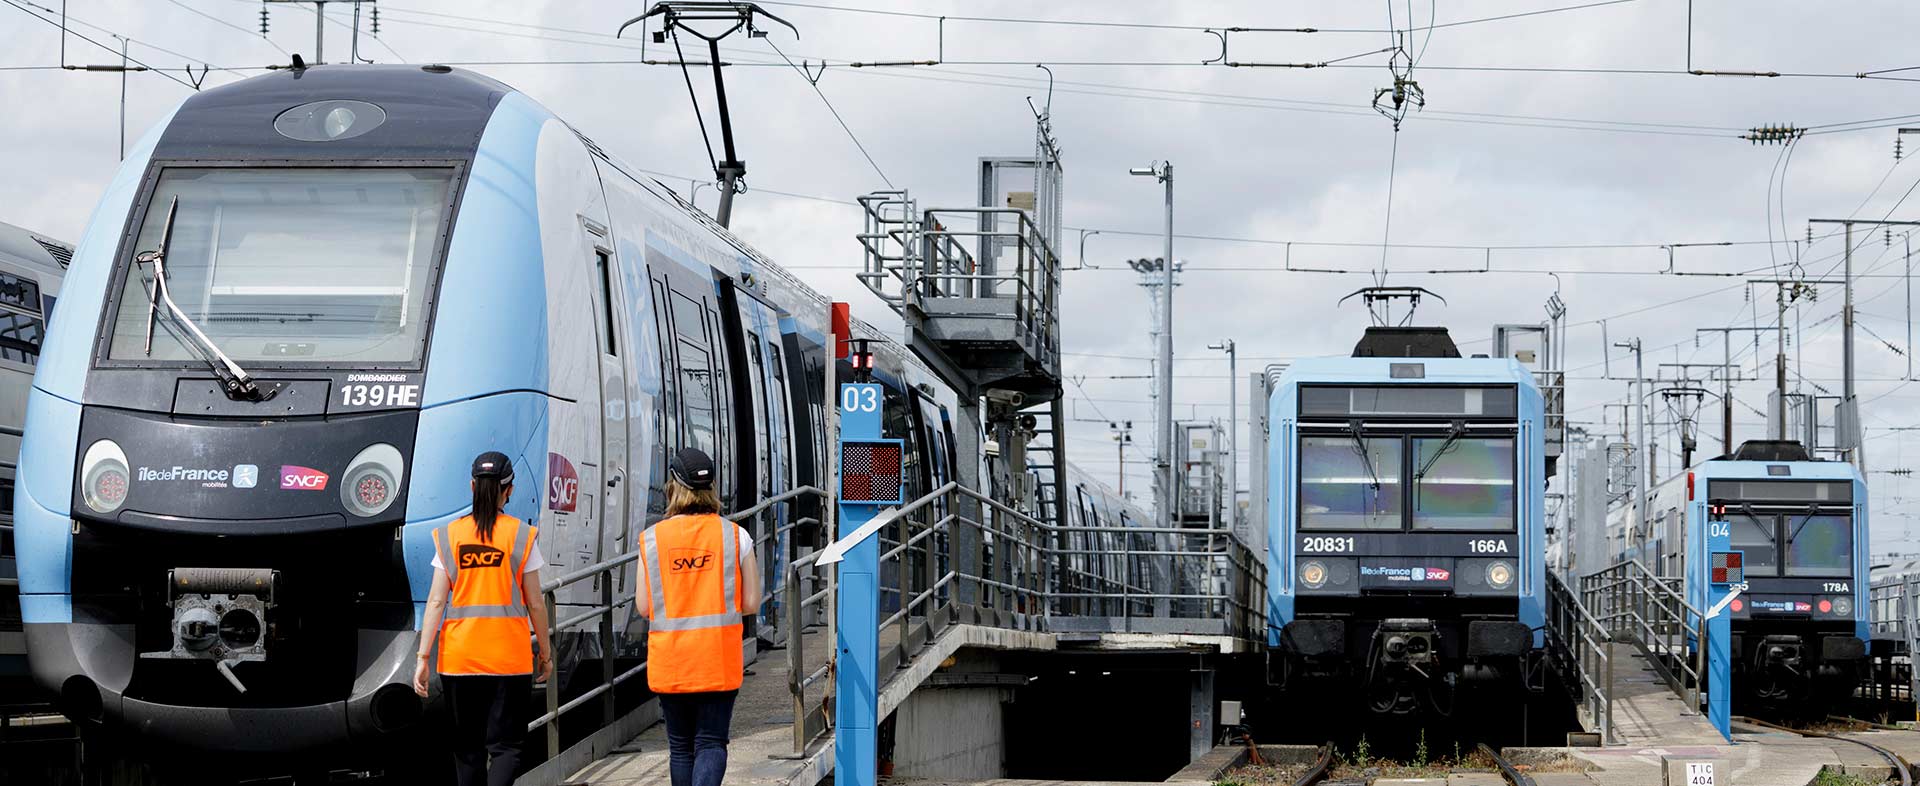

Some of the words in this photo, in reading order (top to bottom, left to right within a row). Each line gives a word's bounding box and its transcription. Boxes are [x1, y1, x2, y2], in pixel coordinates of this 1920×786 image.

[347, 374, 407, 382] BOMBARDIER
[843, 386, 877, 412] 03
[282, 474, 326, 487] SNCF
[550, 476, 577, 504] SNCF
[1711, 523, 1730, 537] 04
[1303, 536, 1354, 552] 20831
[1468, 539, 1509, 553] 166A
[461, 551, 502, 567] SNCF
[672, 554, 713, 571] SNCF
[1426, 571, 1449, 580] SNCF
[1822, 582, 1850, 593] 178A
[1691, 764, 1712, 774] TIC
[1692, 776, 1713, 785] 404
